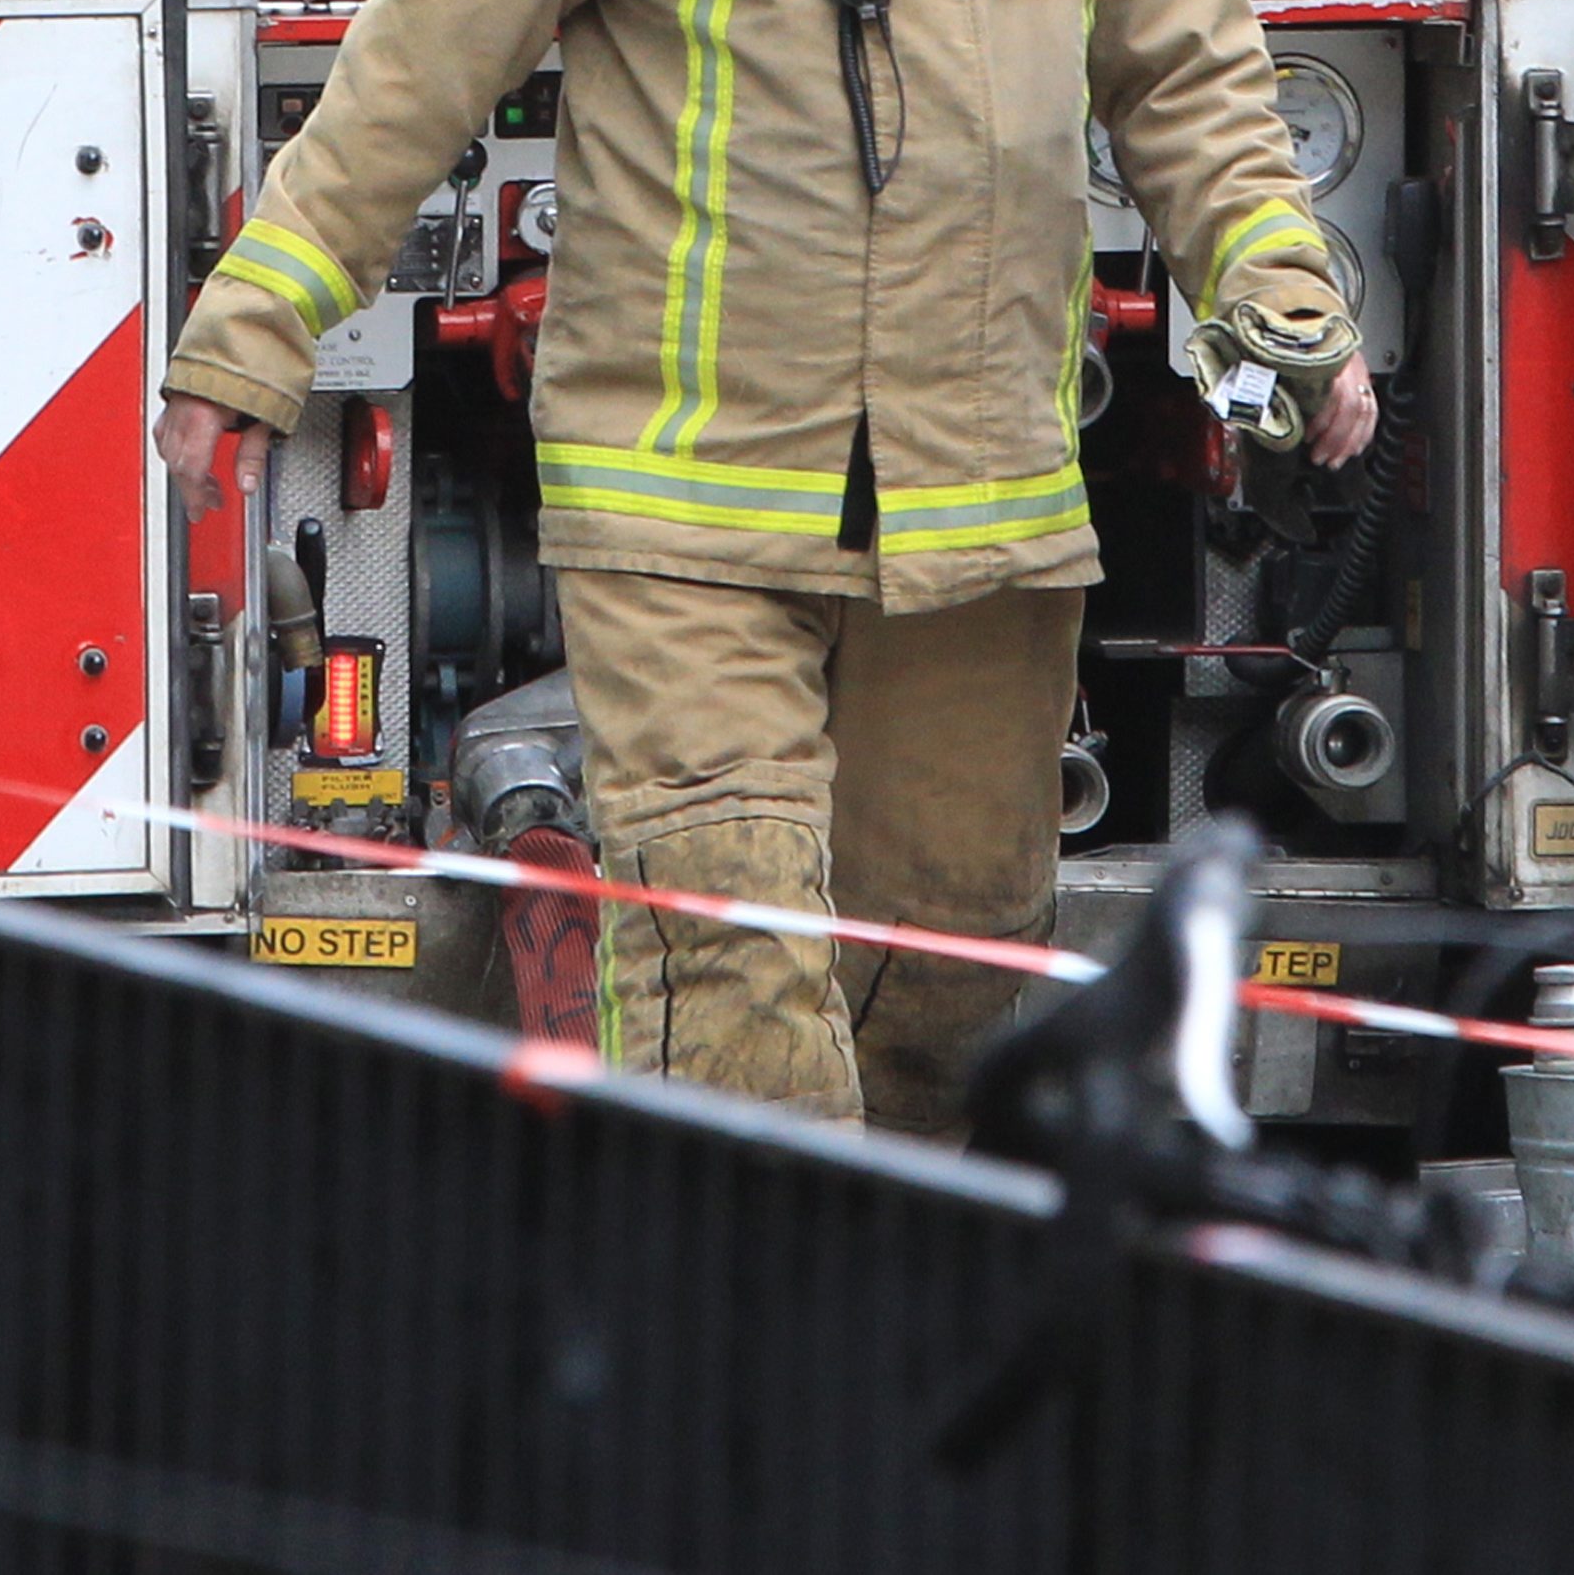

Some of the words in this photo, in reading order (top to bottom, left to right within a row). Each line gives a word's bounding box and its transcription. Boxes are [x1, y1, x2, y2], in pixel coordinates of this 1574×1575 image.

[254, 927, 306, 956] NO
[318, 928, 410, 958] STEP
[1256, 950, 1333, 977] TEP
